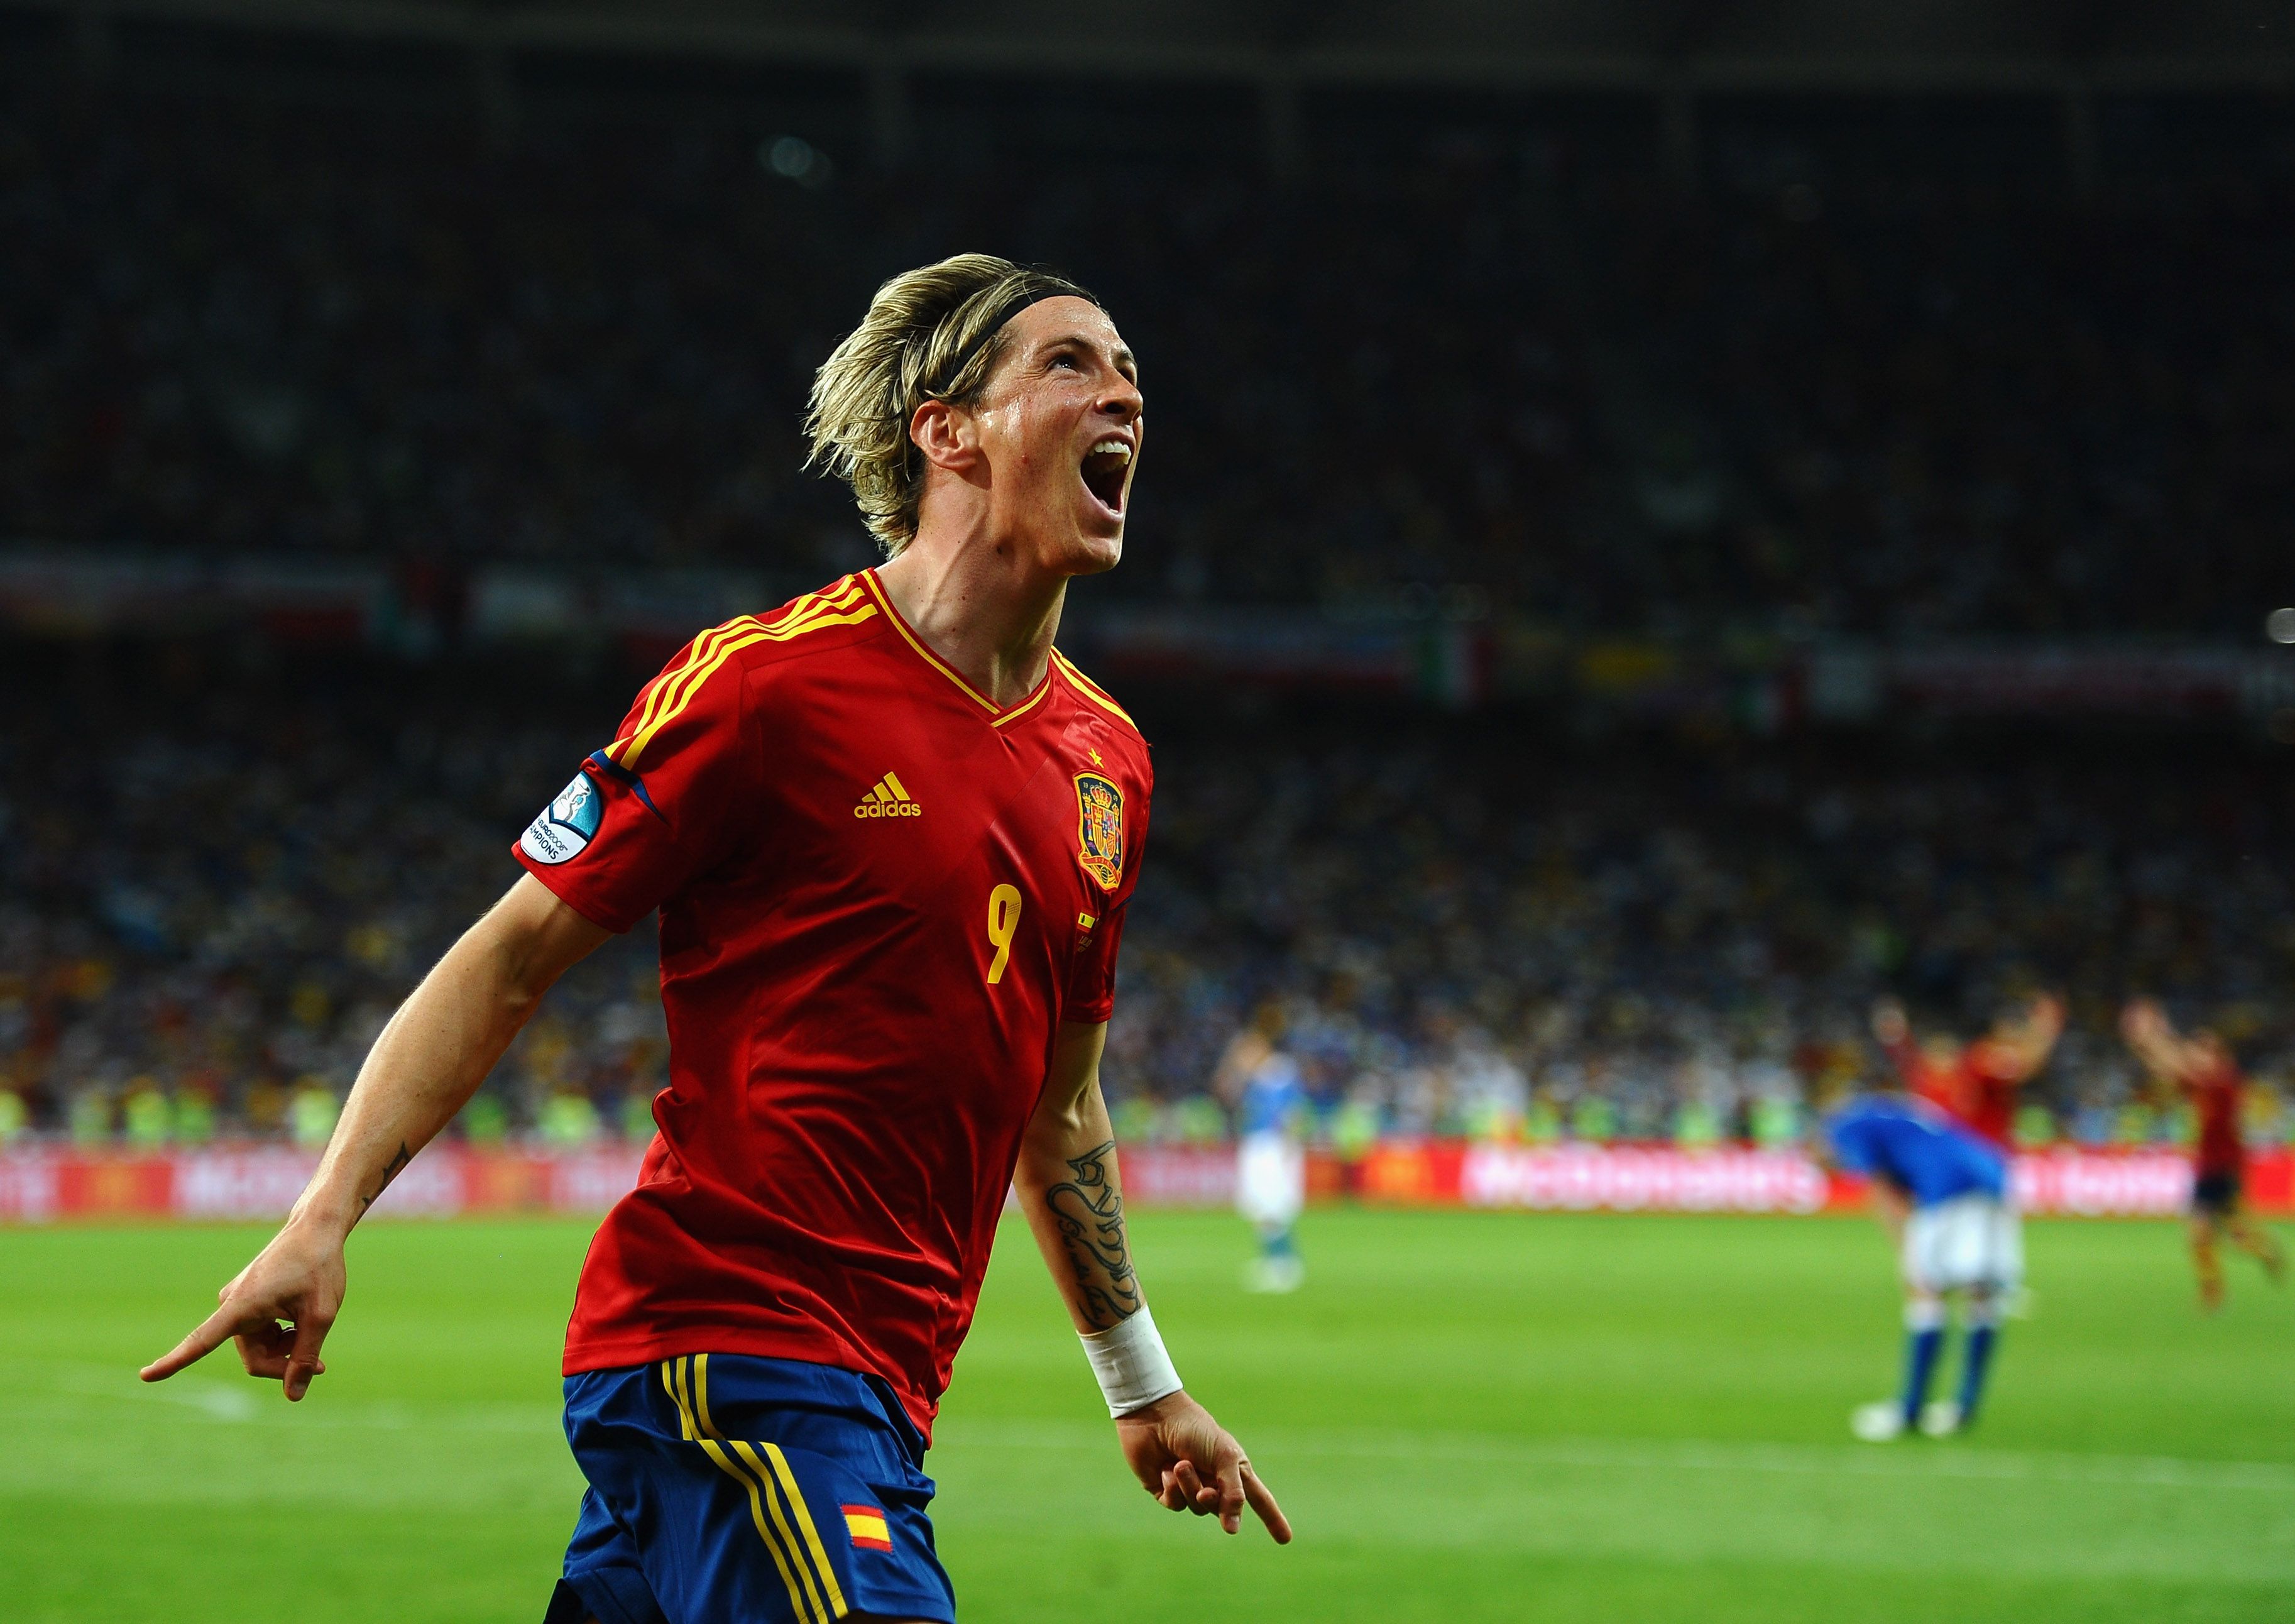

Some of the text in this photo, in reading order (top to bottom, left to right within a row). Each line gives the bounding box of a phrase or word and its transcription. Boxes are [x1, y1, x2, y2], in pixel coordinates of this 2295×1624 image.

[854, 800, 921, 818] adidas
[530, 824, 559, 860] AMPIONS
[987, 884, 1022, 984] 9
